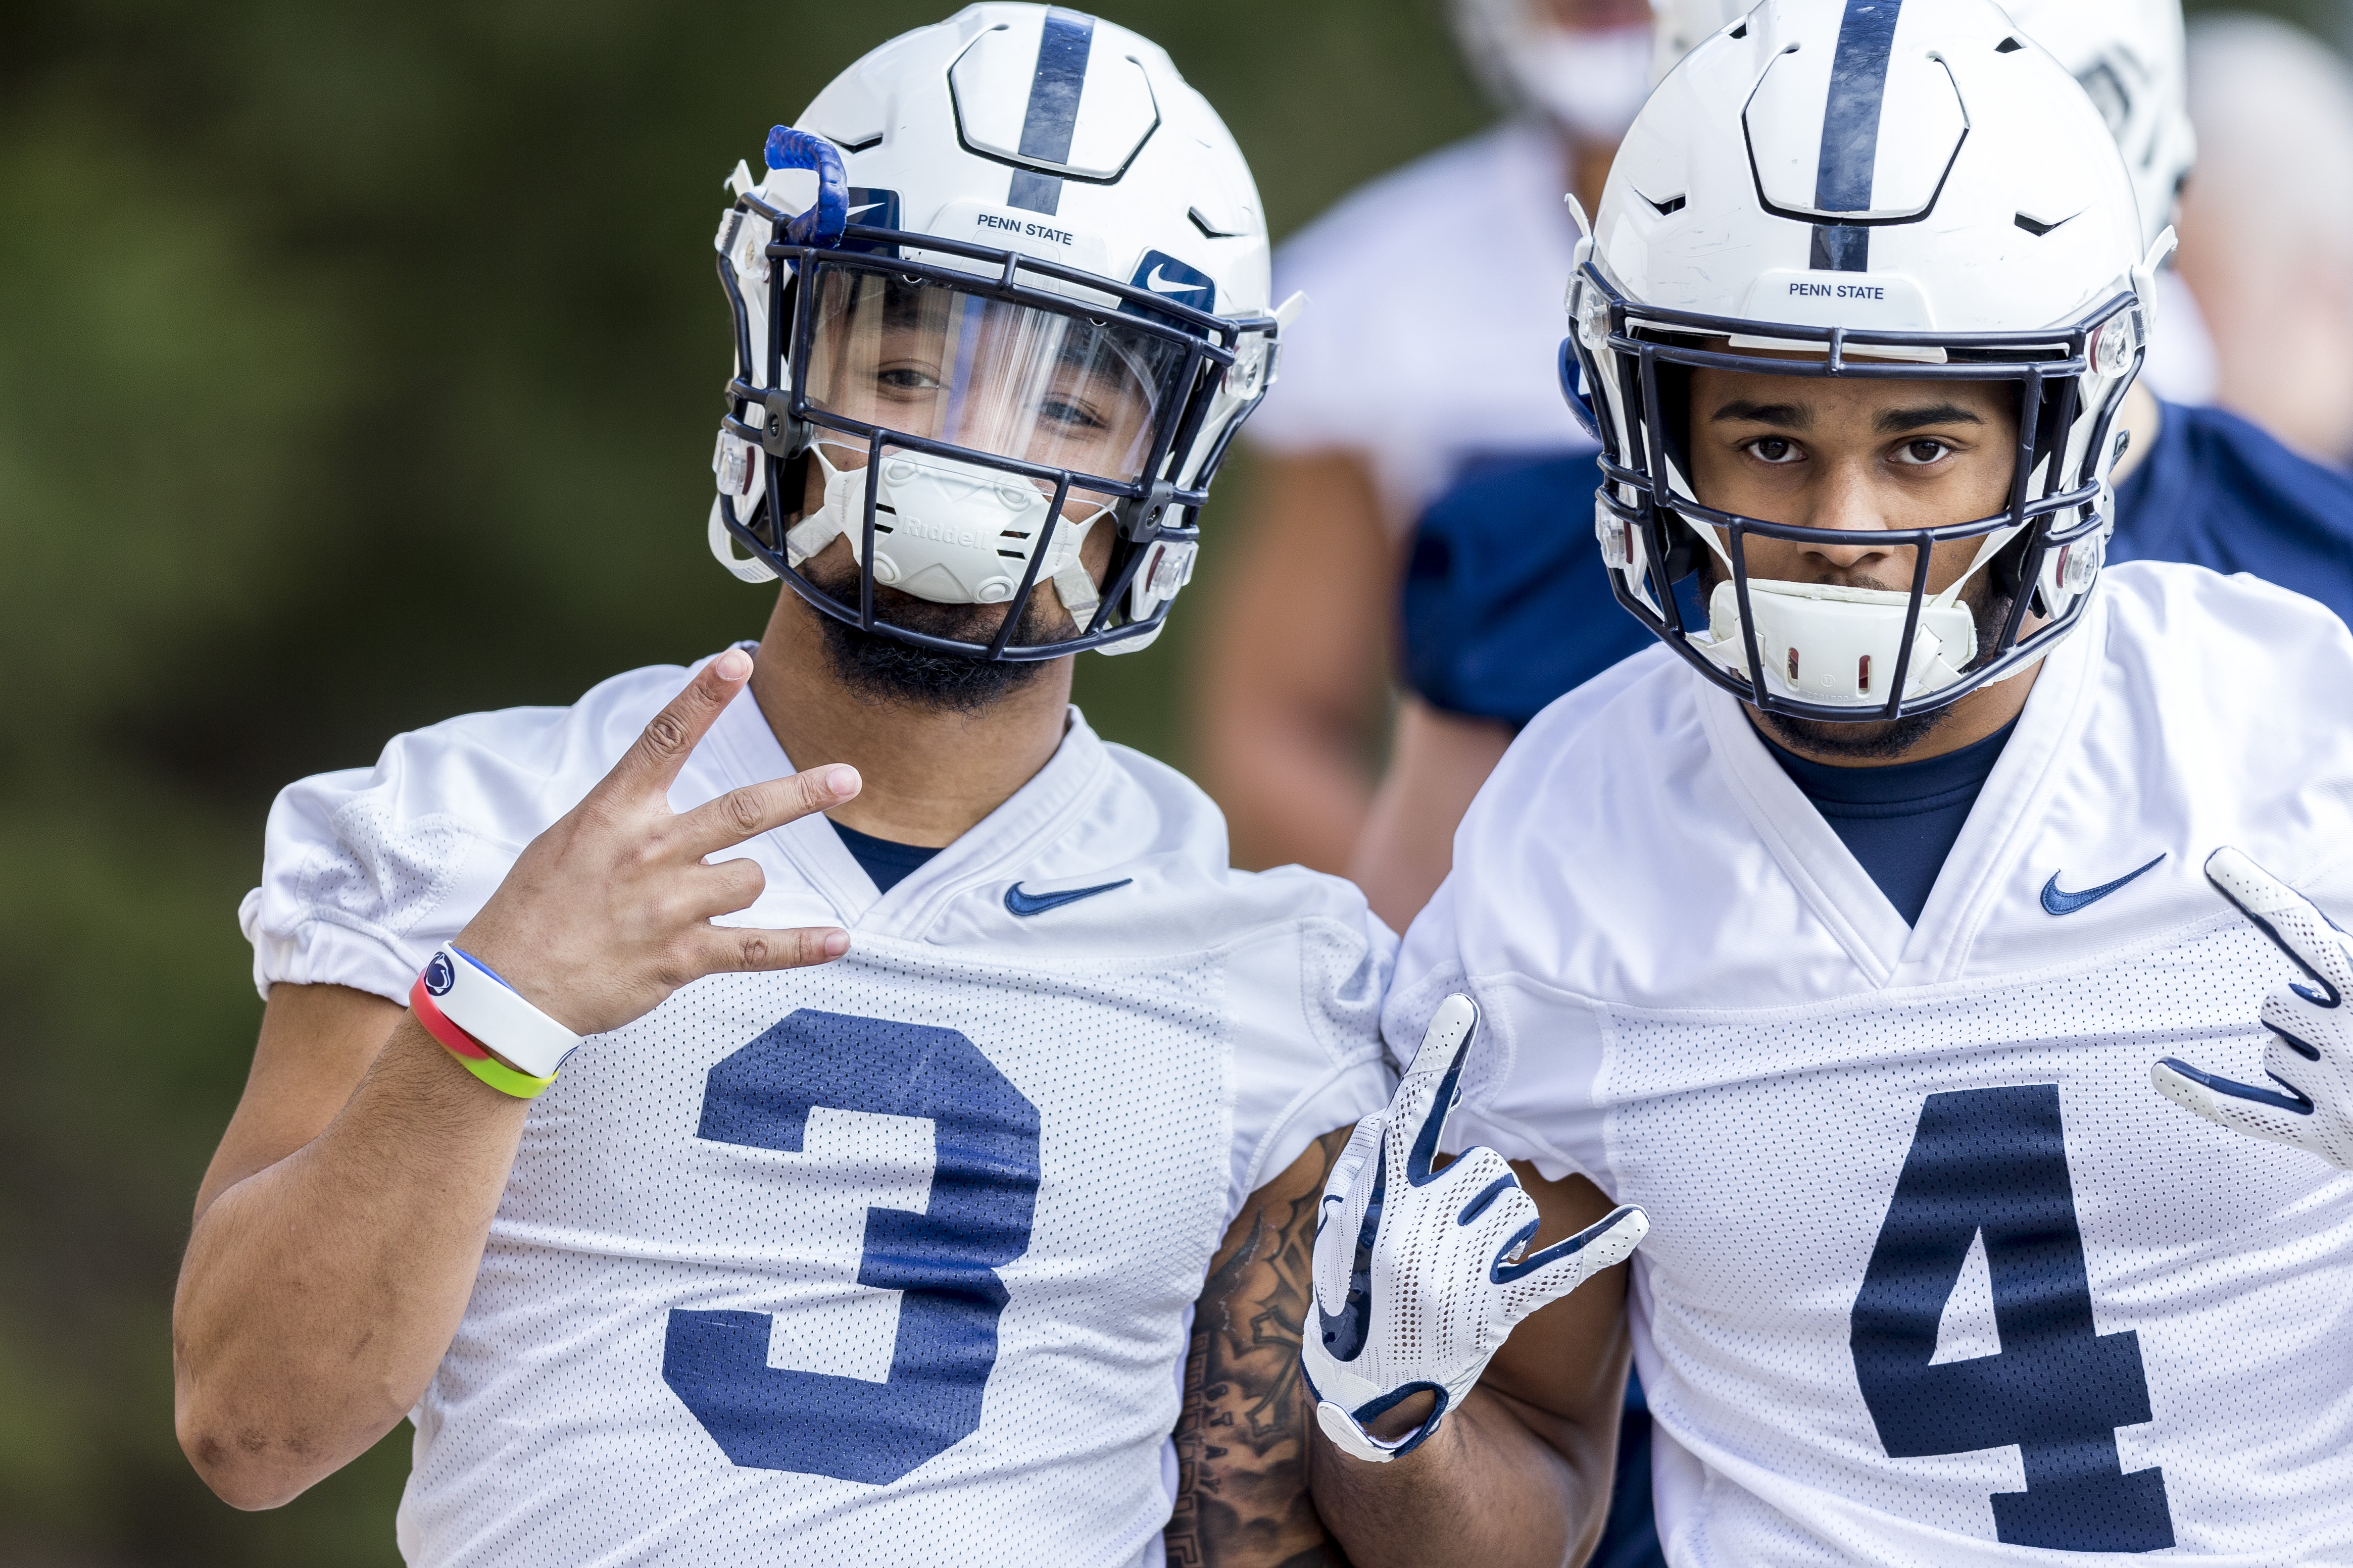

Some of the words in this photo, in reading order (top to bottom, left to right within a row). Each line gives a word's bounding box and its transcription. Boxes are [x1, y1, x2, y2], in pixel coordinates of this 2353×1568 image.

[977, 214, 1021, 232] PENN
[1025, 224, 1073, 246] STATE
[1789, 283, 1832, 296] PENN
[1836, 285, 1884, 300] STATE
[902, 516, 991, 550] Riddell
[662, 1007, 1041, 1486] 3
[1849, 1083, 2176, 1553] 4
